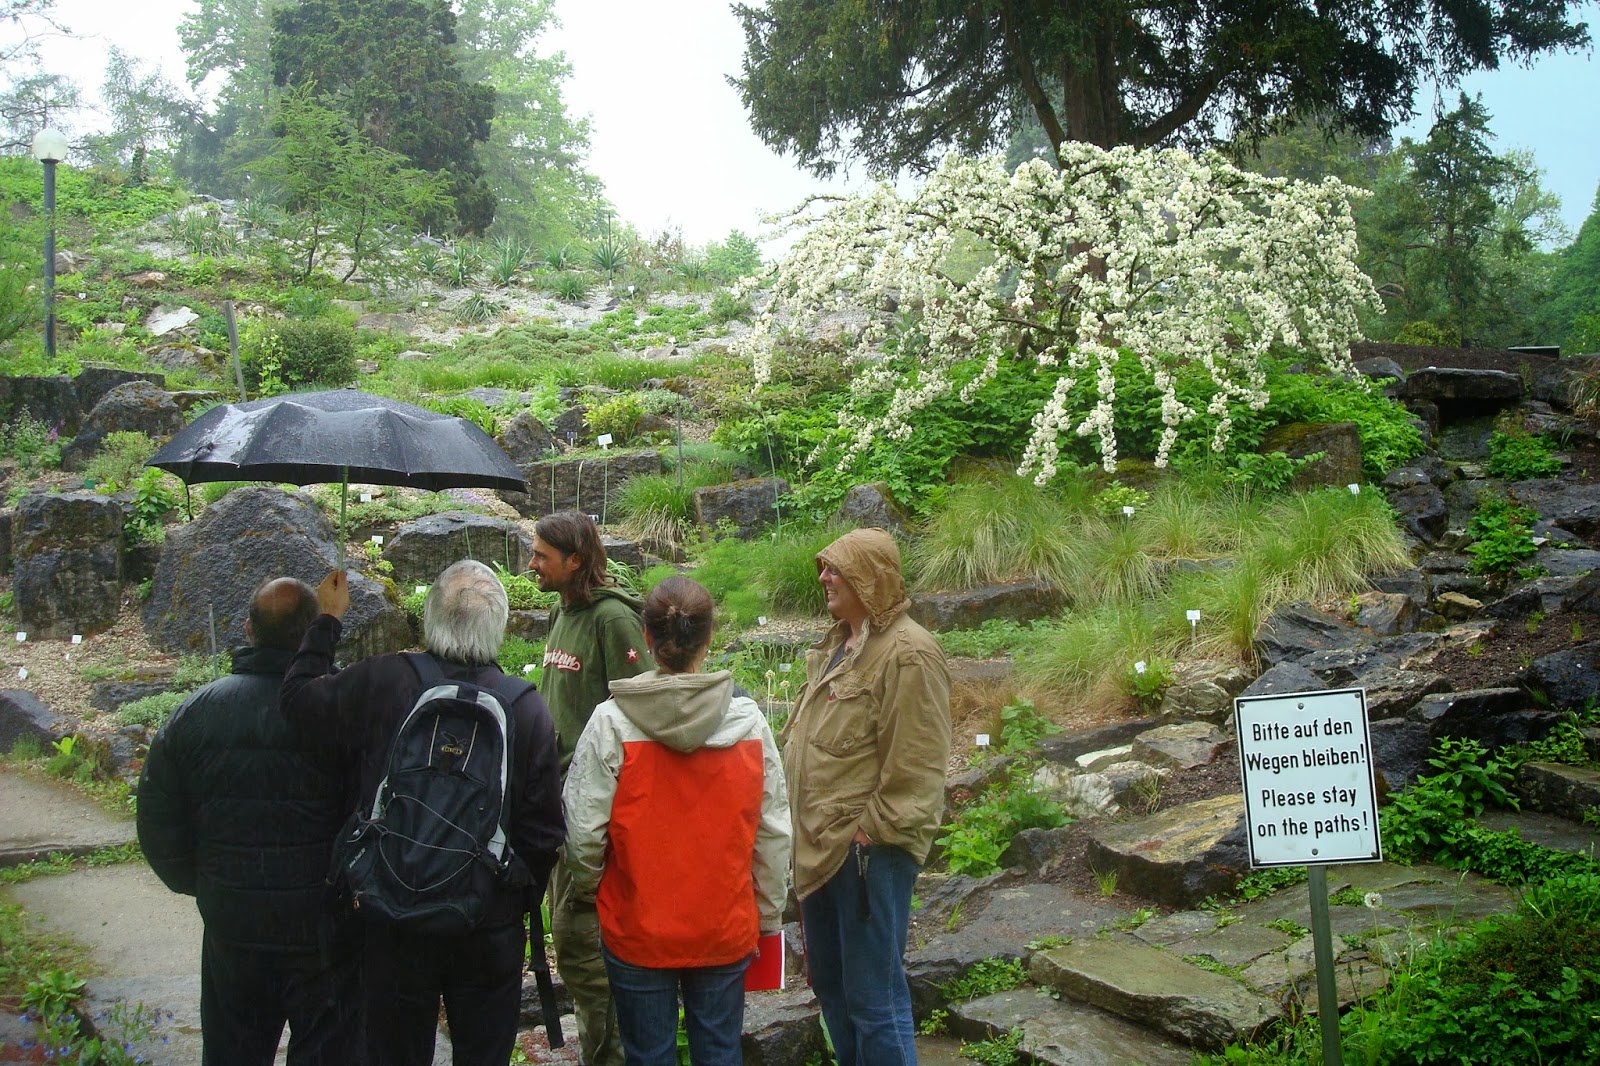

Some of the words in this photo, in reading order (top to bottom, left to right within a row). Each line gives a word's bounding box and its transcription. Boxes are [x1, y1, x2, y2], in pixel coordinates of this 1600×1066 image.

[1252, 723, 1289, 741] Bitte
[1294, 719, 1318, 738] auf
[1323, 718, 1353, 736] den
[1246, 752, 1299, 774] Wegen
[1302, 743, 1366, 767] bleiben!
[1261, 789, 1316, 807] Please
[1322, 785, 1357, 807] stay
[1257, 823, 1277, 837] on
[1282, 817, 1308, 836] the
[1314, 810, 1368, 839] paths!
